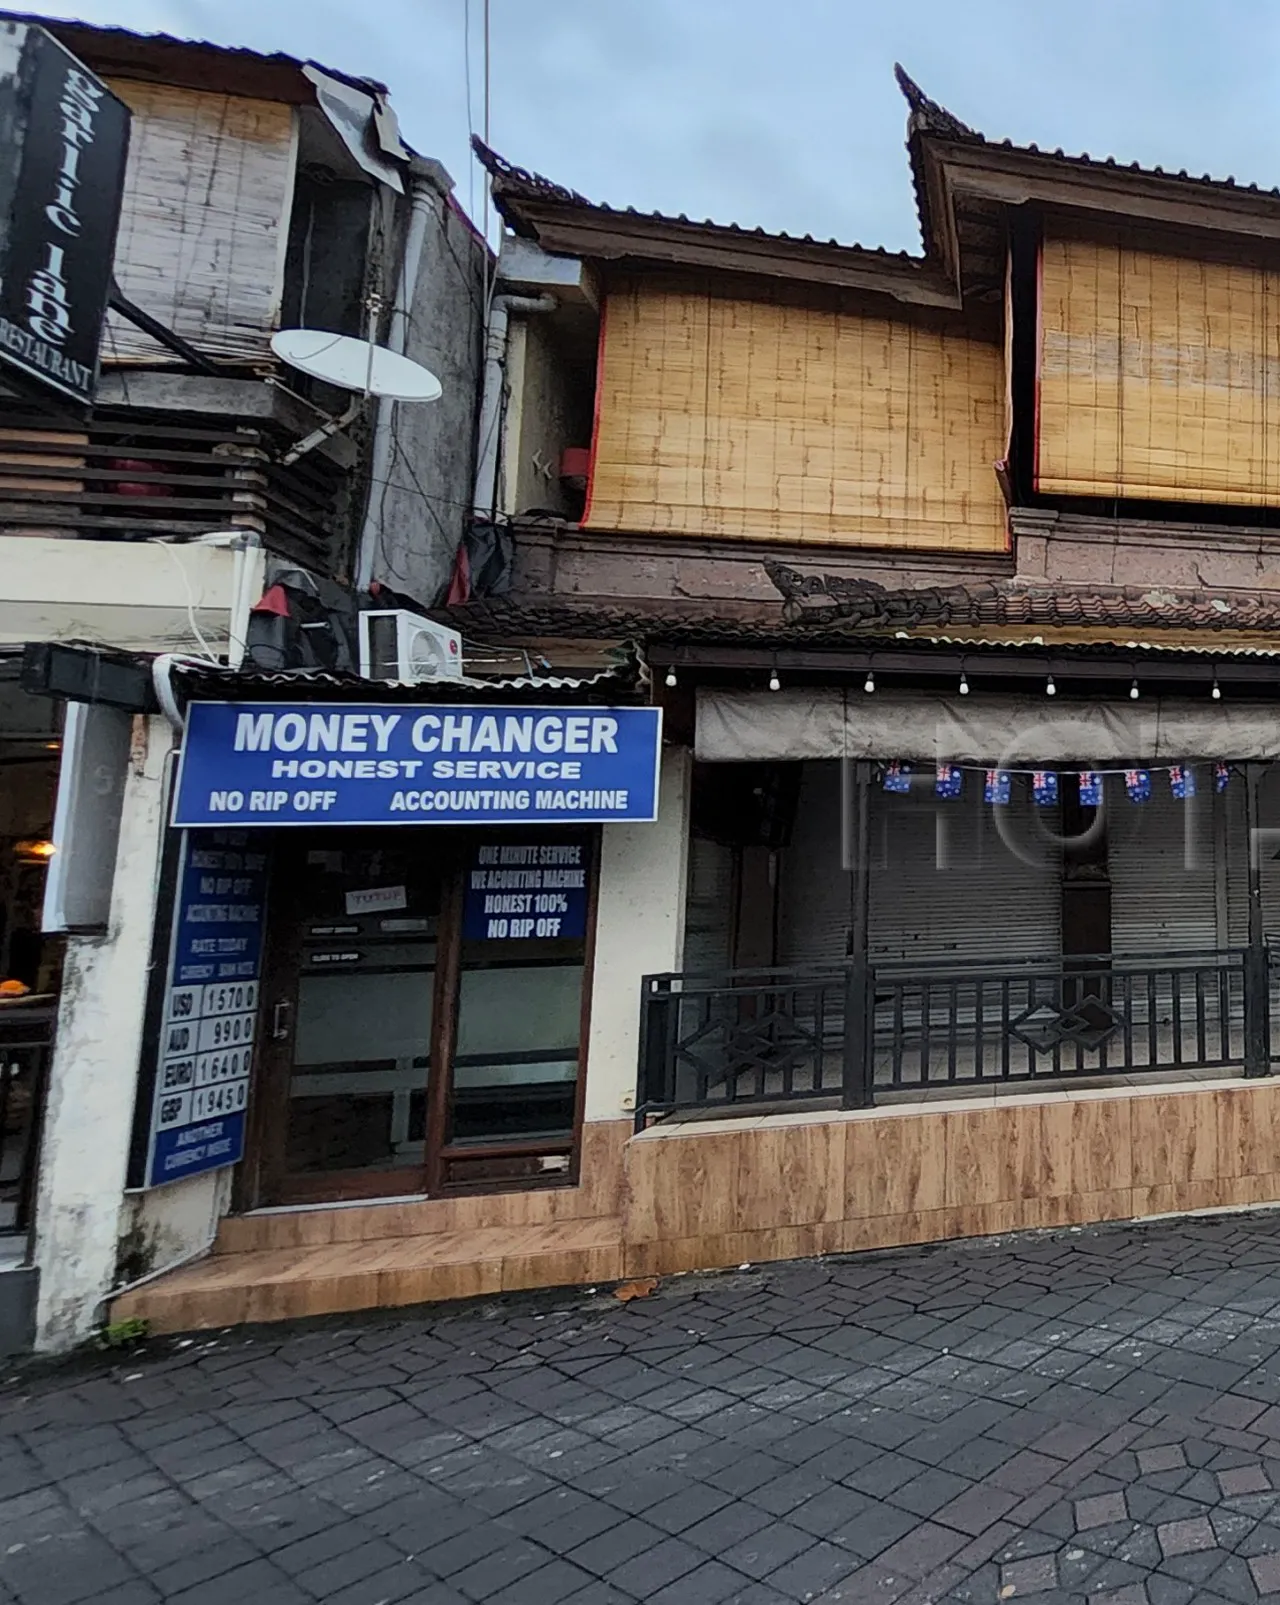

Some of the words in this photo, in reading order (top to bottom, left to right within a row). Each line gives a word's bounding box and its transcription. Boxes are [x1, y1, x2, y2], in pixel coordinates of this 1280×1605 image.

[26, 241, 76, 346] lane
[234, 713, 402, 752] MONEY
[412, 714, 619, 754] CHANGER
[272, 760, 423, 778] HONEST
[432, 760, 582, 779] SERVICE
[209, 791, 244, 811] NO
[250, 791, 288, 811] RIP
[293, 791, 337, 811] OFF
[390, 790, 530, 811] ACCOUNTING
[535, 790, 628, 810] MACHINE
[539, 845, 581, 865] SERVICE
[484, 894, 533, 913] HONEST
[534, 893, 569, 913] 100%
[488, 918, 508, 938] NO
[510, 918, 535, 938] RIP
[536, 918, 561, 937] OFF
[208, 985, 254, 1012] 15700
[214, 1017, 252, 1045] 9900
[201, 1050, 250, 1082] 16400
[197, 1084, 244, 1115] 19450
